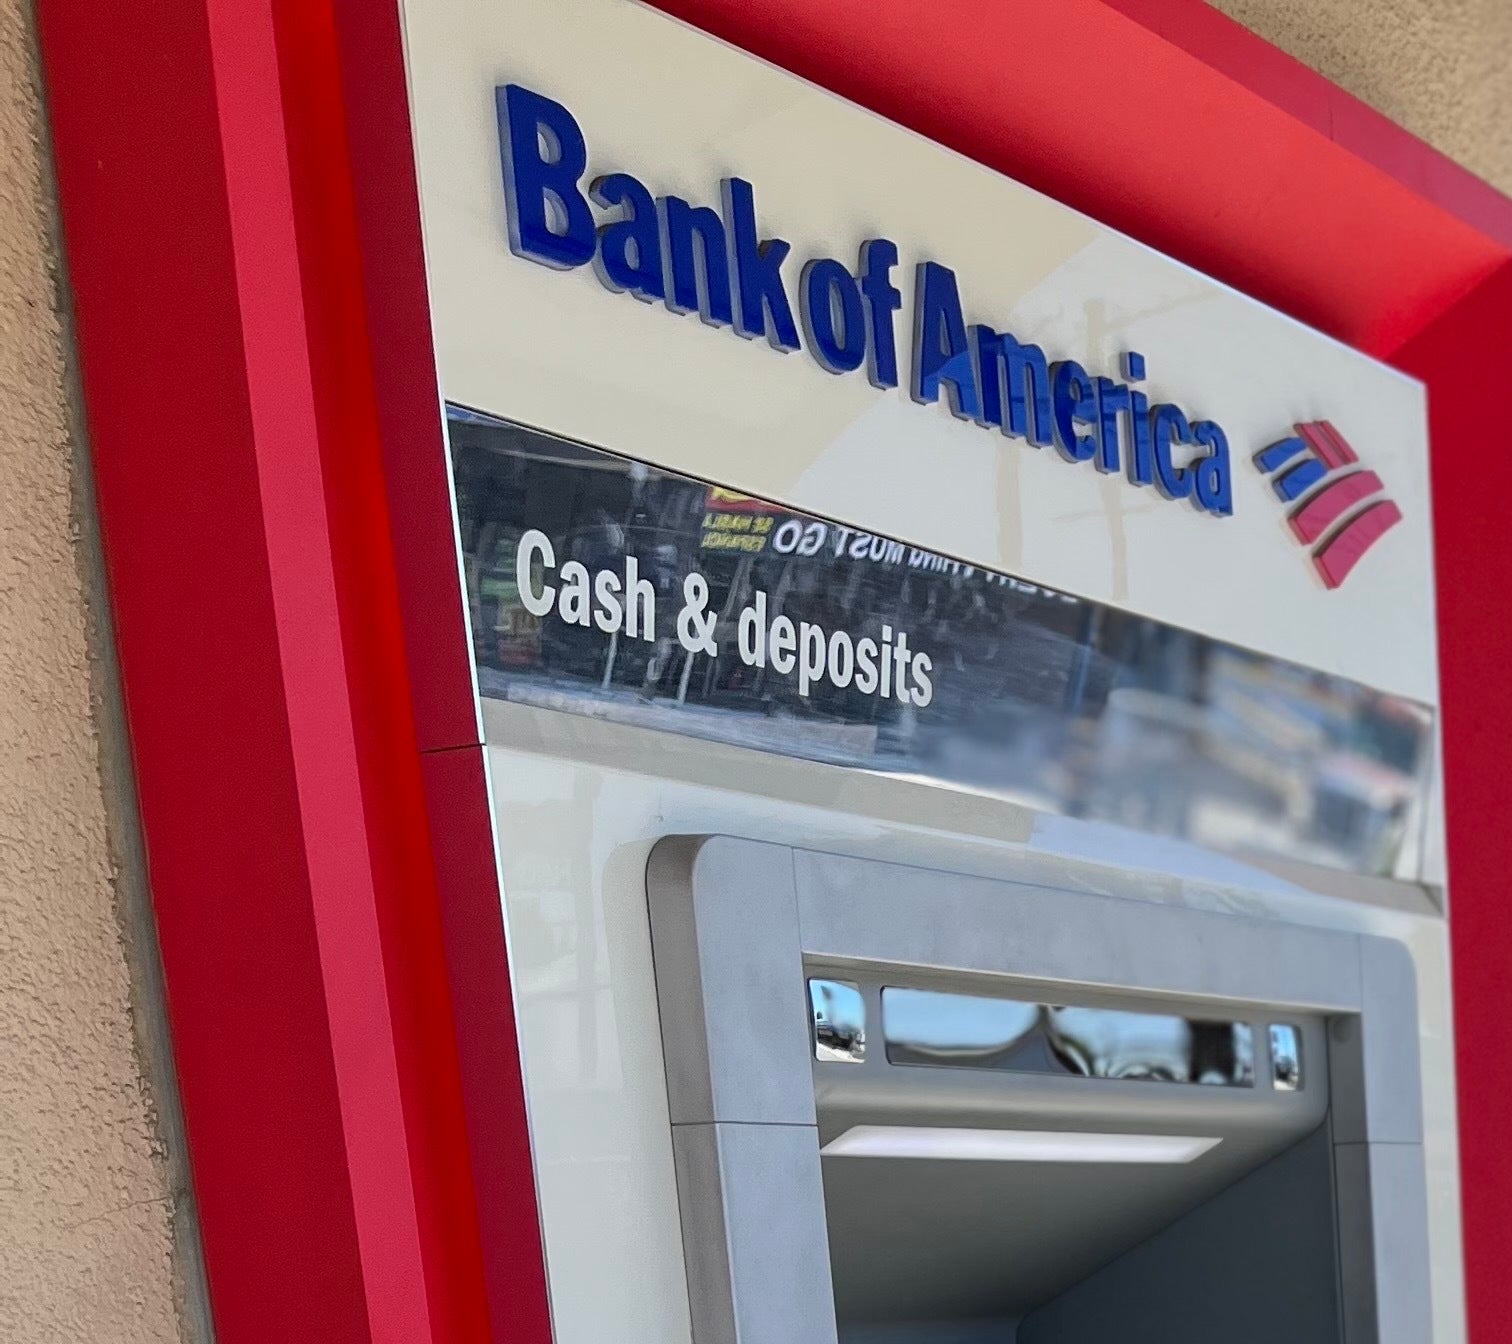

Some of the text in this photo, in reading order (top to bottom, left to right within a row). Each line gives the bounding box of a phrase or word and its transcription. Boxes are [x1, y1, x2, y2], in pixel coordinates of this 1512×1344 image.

[495, 83, 1233, 517] Bank of America
[516, 528, 933, 708] Cash & deposits
